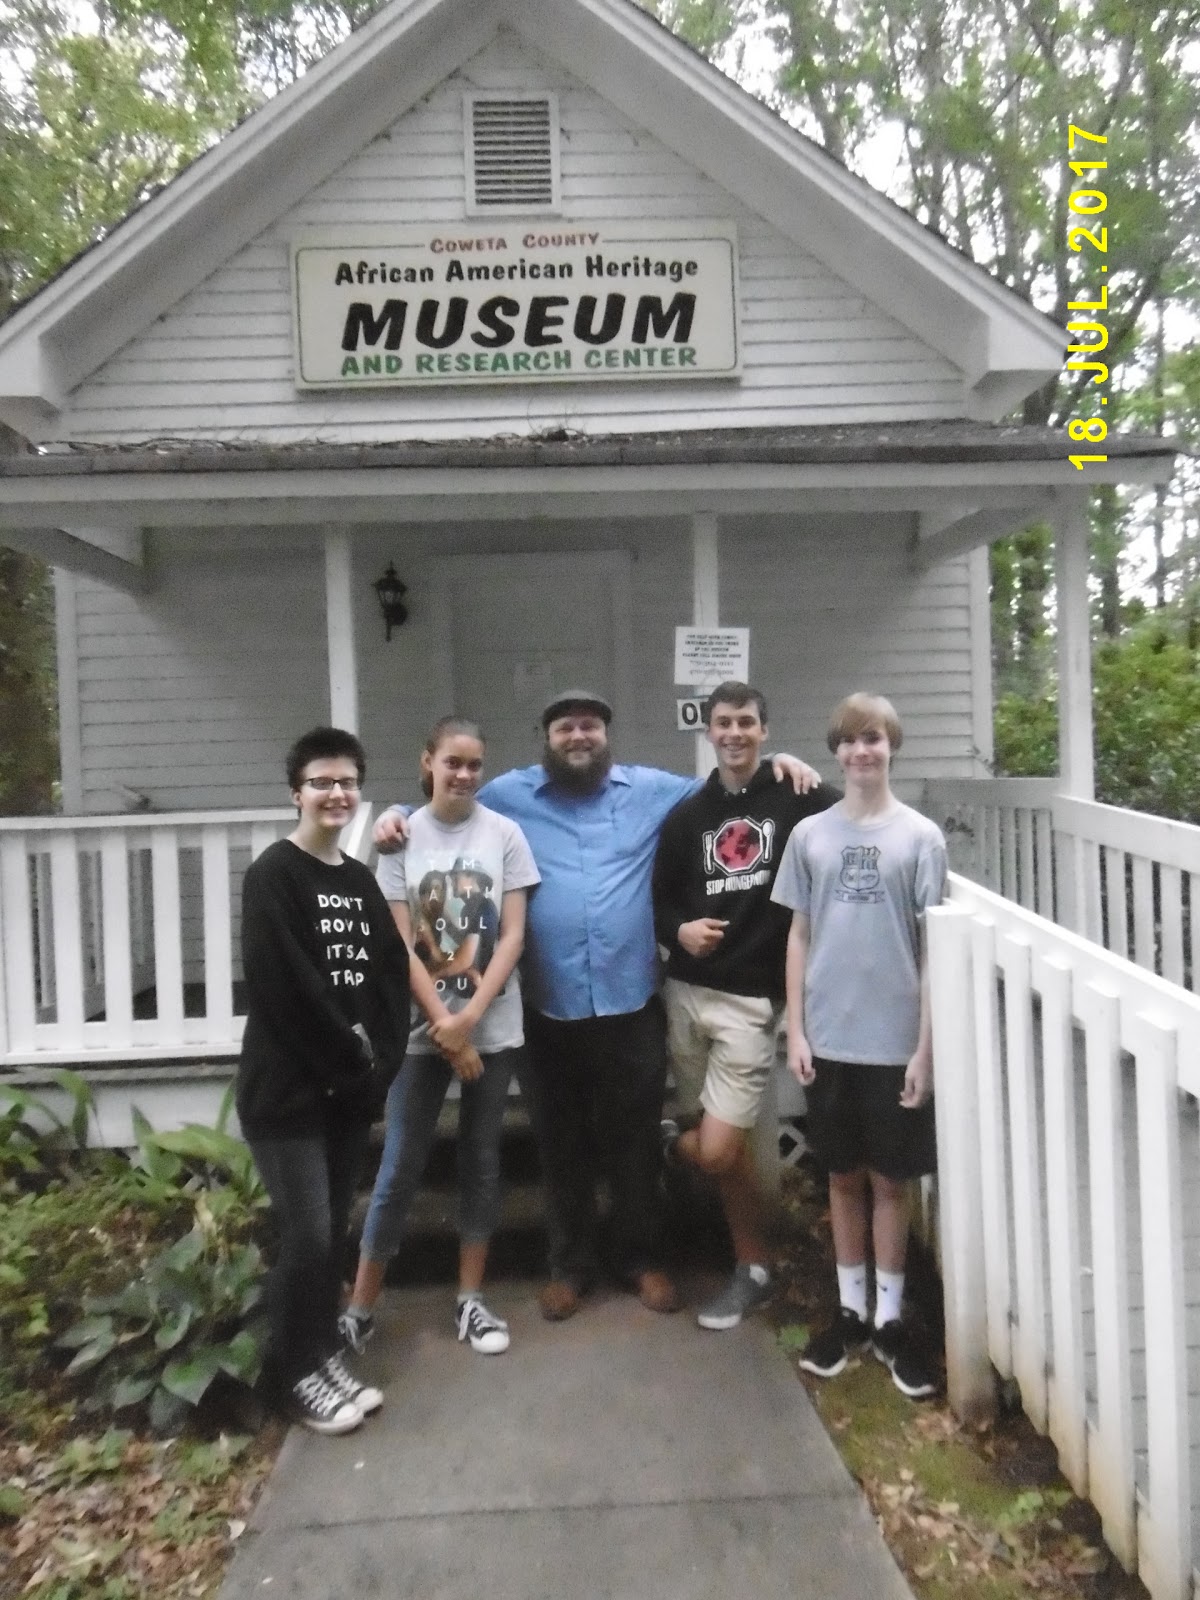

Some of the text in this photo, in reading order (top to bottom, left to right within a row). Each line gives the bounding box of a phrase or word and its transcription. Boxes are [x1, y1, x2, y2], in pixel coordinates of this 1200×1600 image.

[430, 232, 599, 254] COWETA COUNTY
[335, 254, 699, 285] African American Heritage
[341, 292, 697, 352] MUSEUM
[341, 346, 698, 376] AND RESEARCH CENTER
[706, 878, 725, 896] STOP
[317, 894, 363, 911] DON'T
[355, 946, 370, 961] A
[447, 951, 455, 961] 2
